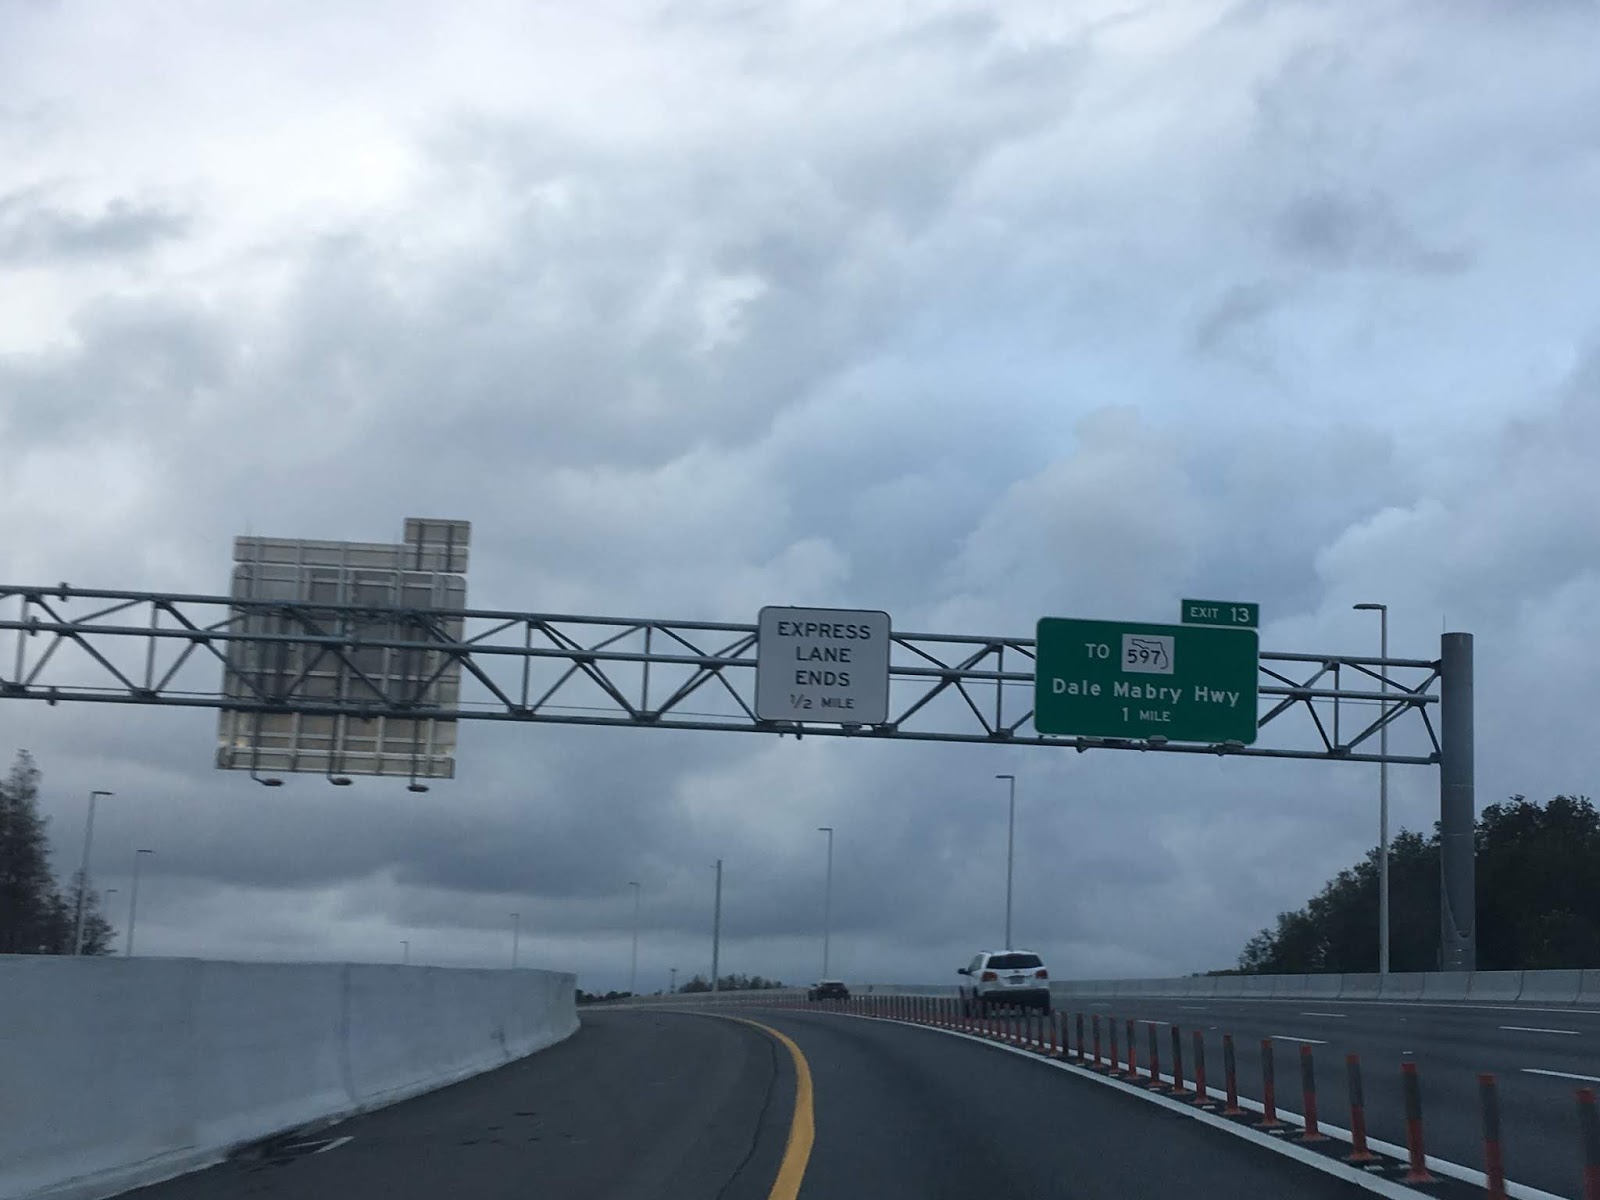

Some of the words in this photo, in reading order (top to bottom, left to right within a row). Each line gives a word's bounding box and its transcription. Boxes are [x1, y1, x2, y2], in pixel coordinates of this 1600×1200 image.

[1190, 606, 1219, 619] EXIT
[1230, 607, 1250, 623] 13
[777, 621, 872, 640] EXPRESS
[796, 646, 852, 663] LANE
[1084, 643, 1110, 659] TO
[1127, 649, 1161, 665] 597
[795, 670, 851, 687] ENDS
[1052, 678, 1101, 696] Dale
[1113, 681, 1182, 704] Mabry
[1194, 686, 1240, 708] Hwy
[821, 697, 855, 709] MILE
[1121, 707, 1129, 722] 1
[1139, 709, 1171, 722] MILE
